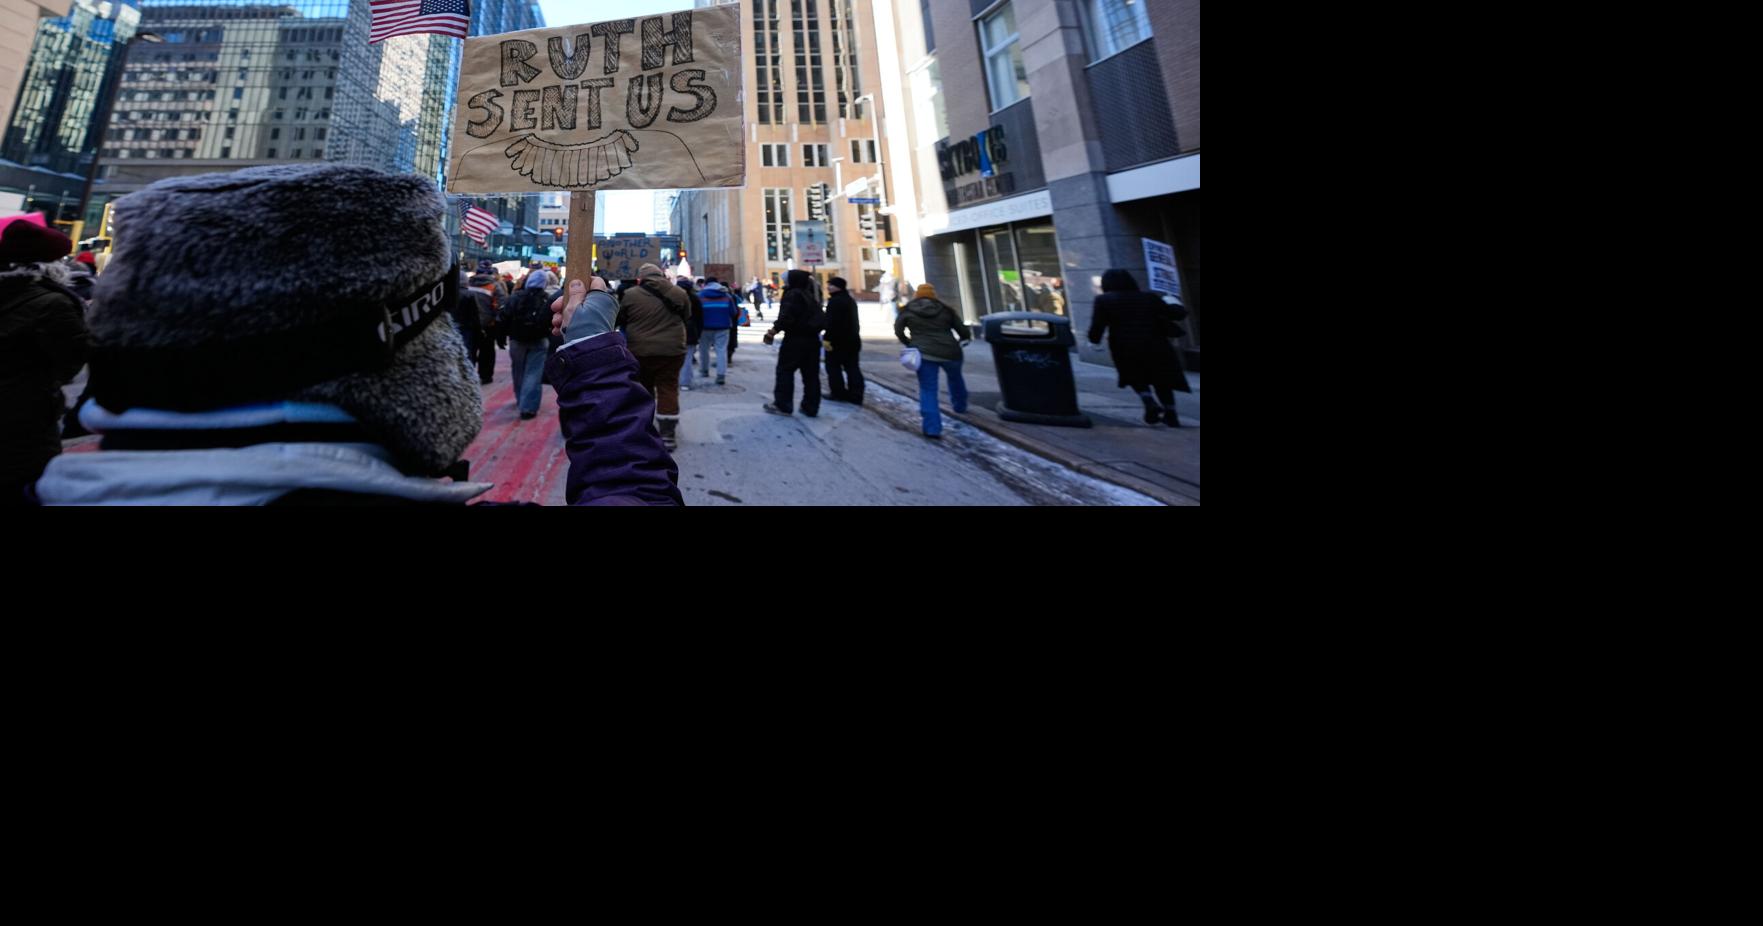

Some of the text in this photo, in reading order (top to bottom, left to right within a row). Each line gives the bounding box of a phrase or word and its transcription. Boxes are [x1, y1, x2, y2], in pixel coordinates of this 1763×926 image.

[500, 11, 694, 87] RUTH
[466, 69, 717, 138] SENT US
